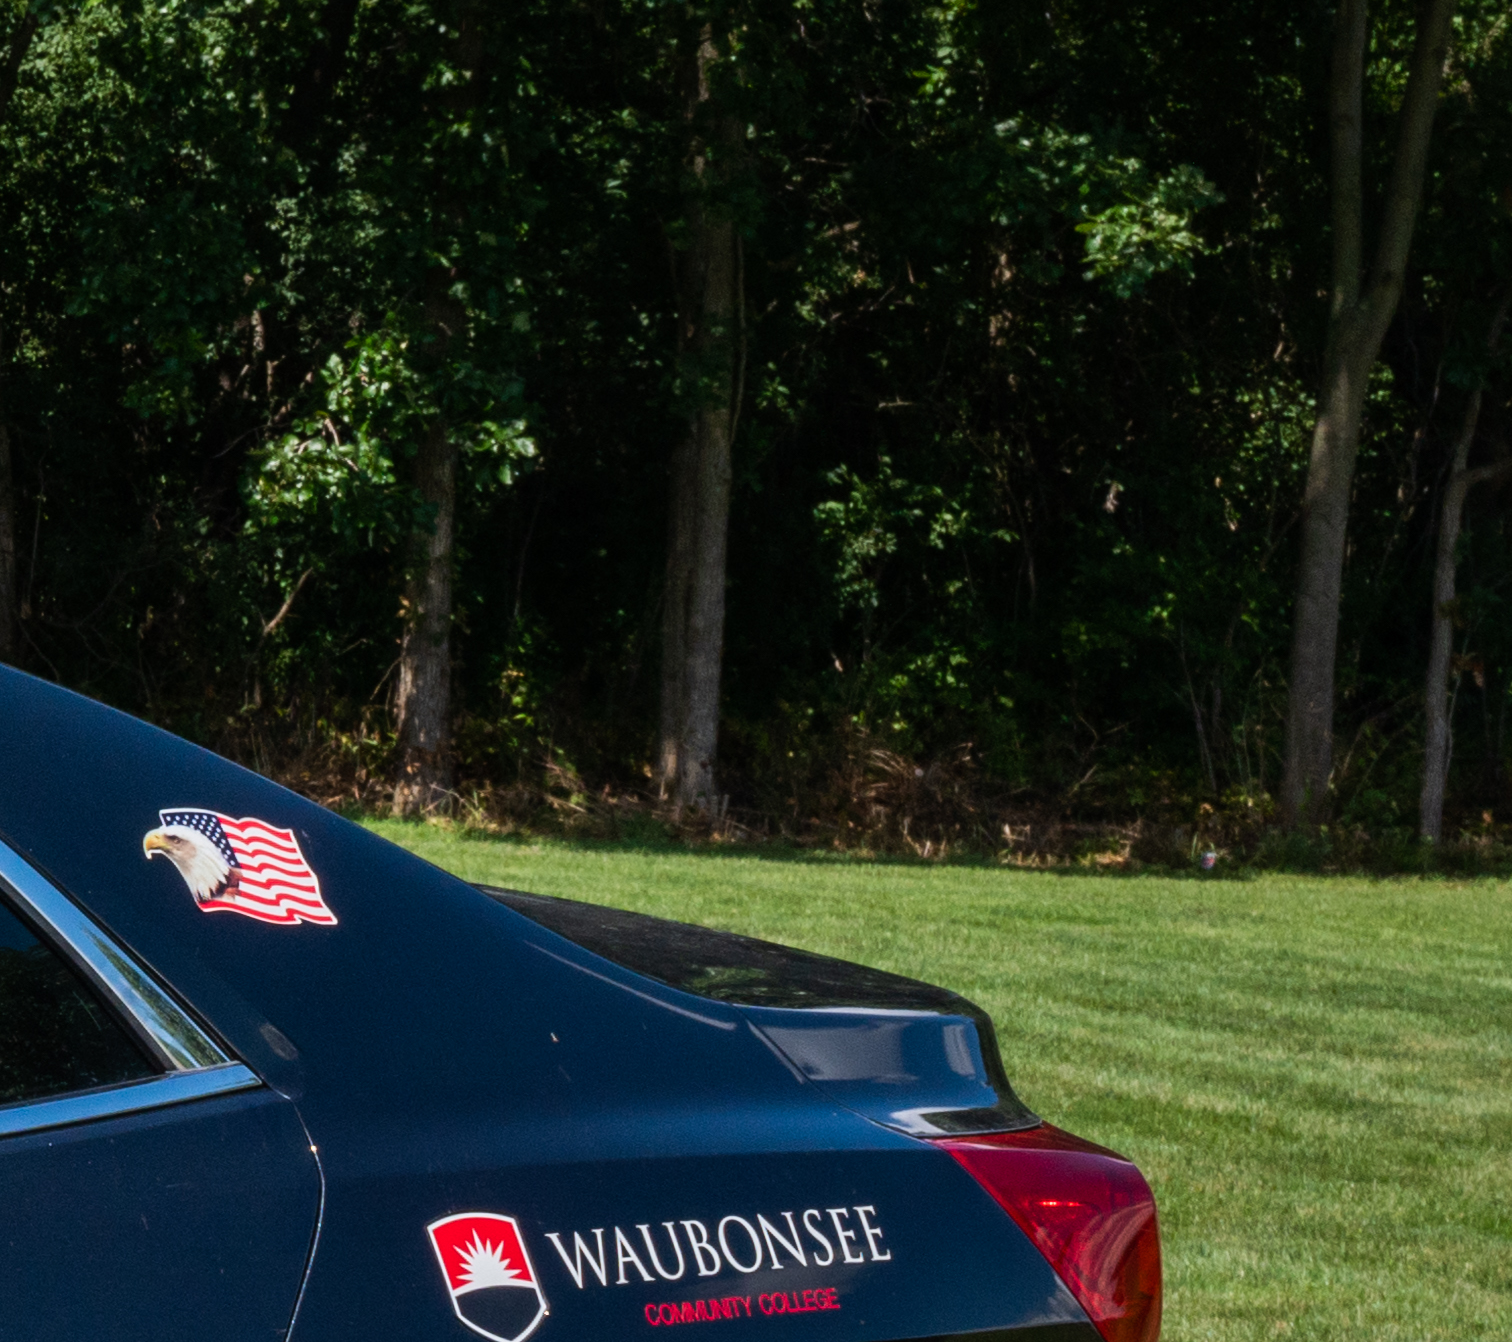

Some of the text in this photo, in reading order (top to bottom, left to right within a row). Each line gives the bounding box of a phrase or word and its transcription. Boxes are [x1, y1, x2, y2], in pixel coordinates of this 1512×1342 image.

[544, 1205, 892, 1290] WAUBONSEE
[644, 1288, 841, 1327] COMMUNITY COLLEGE
